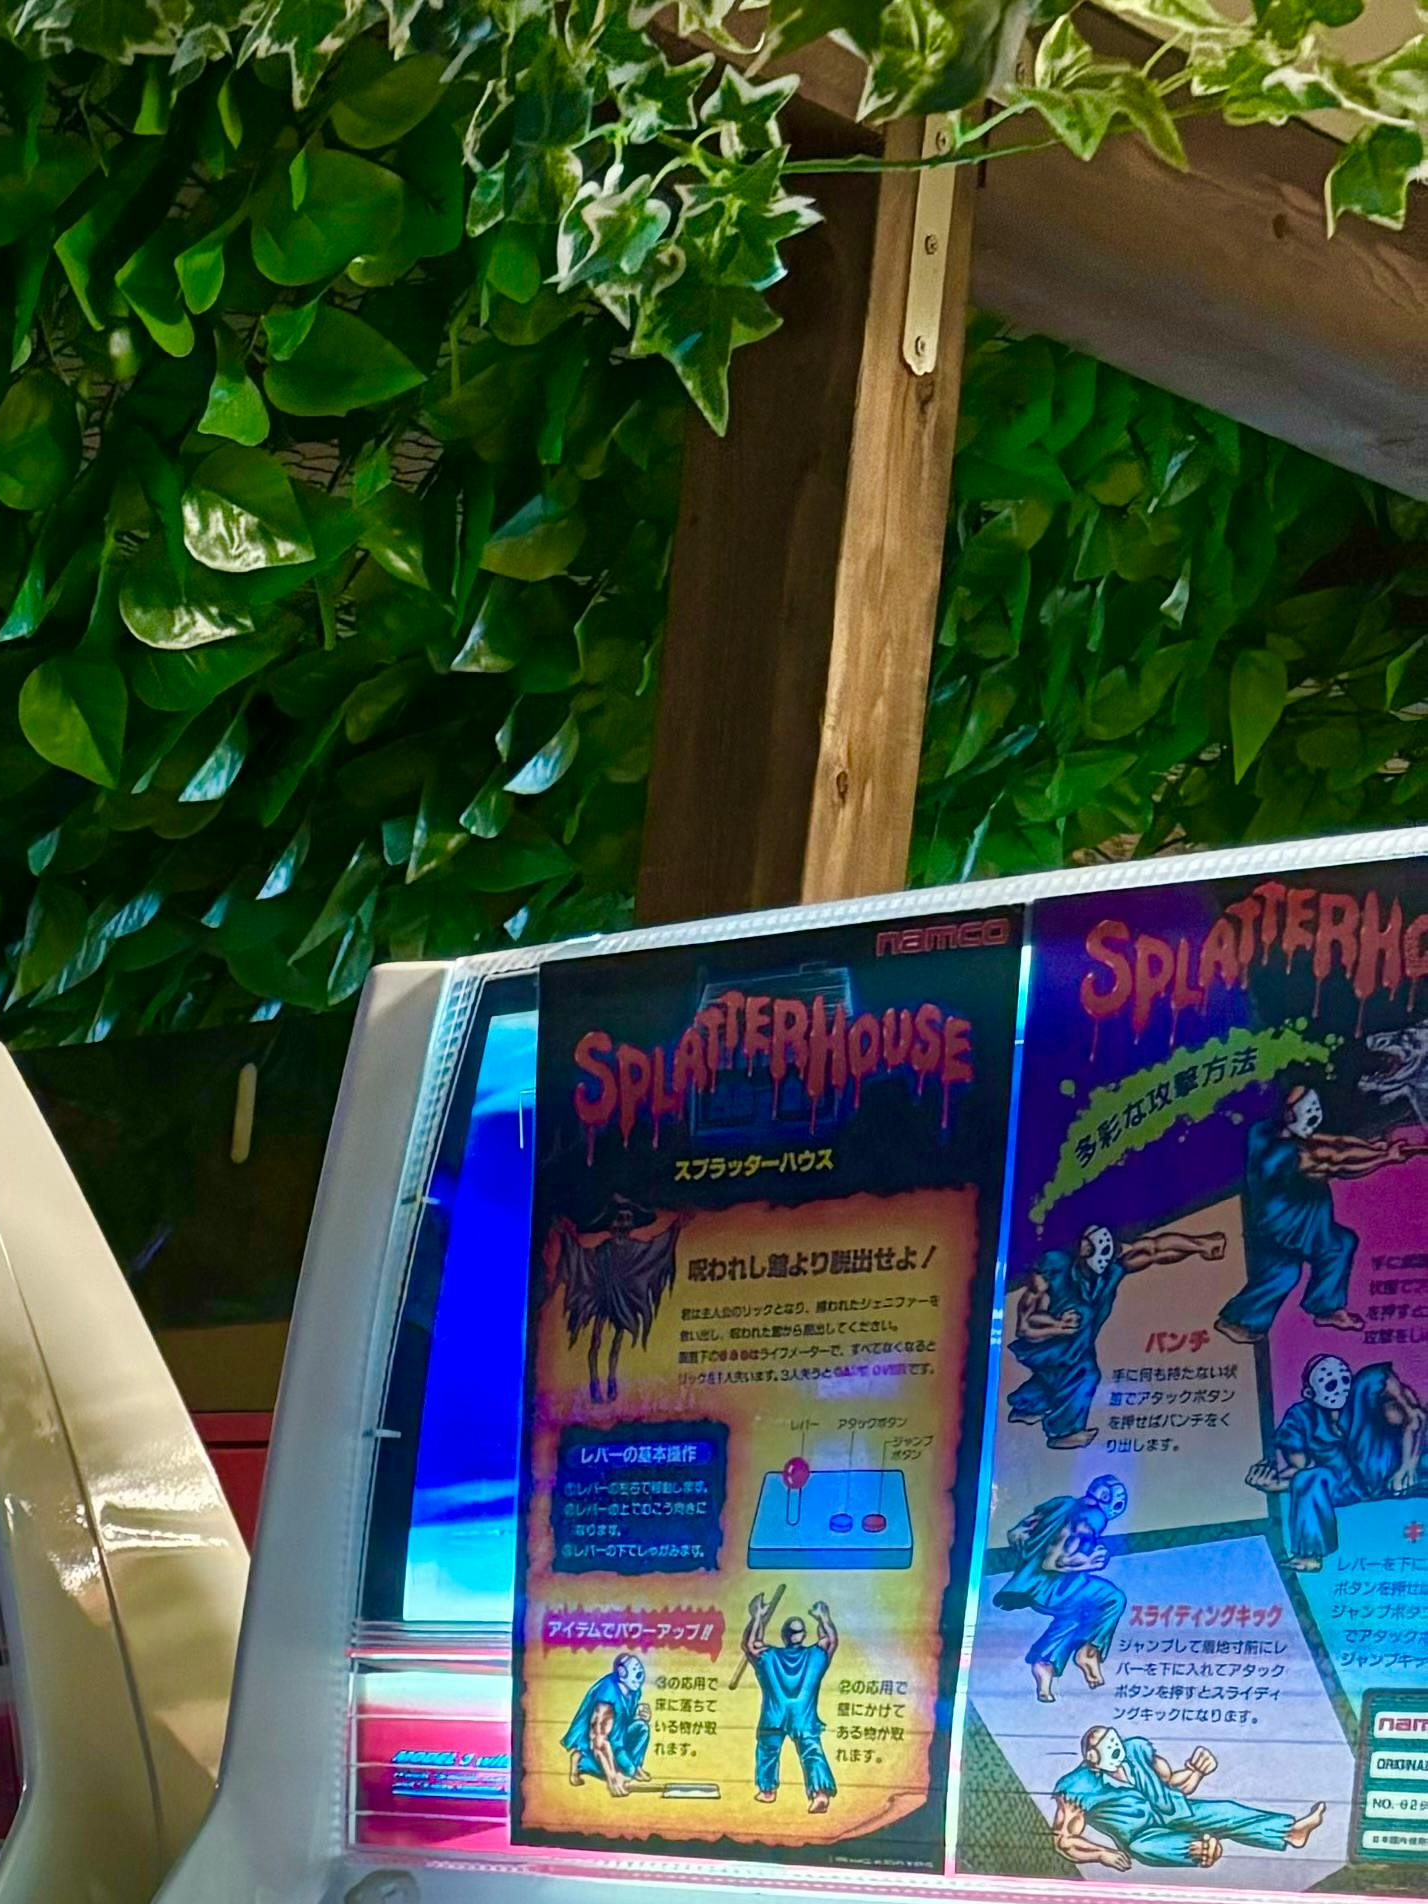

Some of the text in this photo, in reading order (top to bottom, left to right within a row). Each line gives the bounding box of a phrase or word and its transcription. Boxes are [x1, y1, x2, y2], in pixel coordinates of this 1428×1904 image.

[875, 917, 1011, 957] namco
[574, 989, 975, 1168] SPLATTERHOUSE
[1075, 1047, 1259, 1168] 多彩な攻撃方法
[674, 1148, 834, 1181] スプラッターハウス
[1145, 1329, 1210, 1354] パンチ
[1112, 1364, 1238, 1383] 手に何も持たない状
[790, 1418, 820, 1431] レバー
[837, 1416, 908, 1431] アタックボタン
[890, 1435, 935, 1448] ジャンプ
[1106, 1438, 1180, 1454] り出します。
[580, 1445, 697, 1465] レバーの基本操作
[890, 1449, 922, 1461] ボタン
[1129, 1604, 1284, 1628] スライディングキック
[1116, 1662, 1286, 1679] バーを下に入れてアタック
[1114, 1685, 1280, 1701] ボタンを押すとスライディ
[655, 1699, 717, 1713] 床に落ちて
[837, 1703, 906, 1719] 壁にかけて
[1112, 1707, 1258, 1724] ングキックになります。
[654, 1742, 697, 1758] れます。
[835, 1749, 883, 1765] れます。
